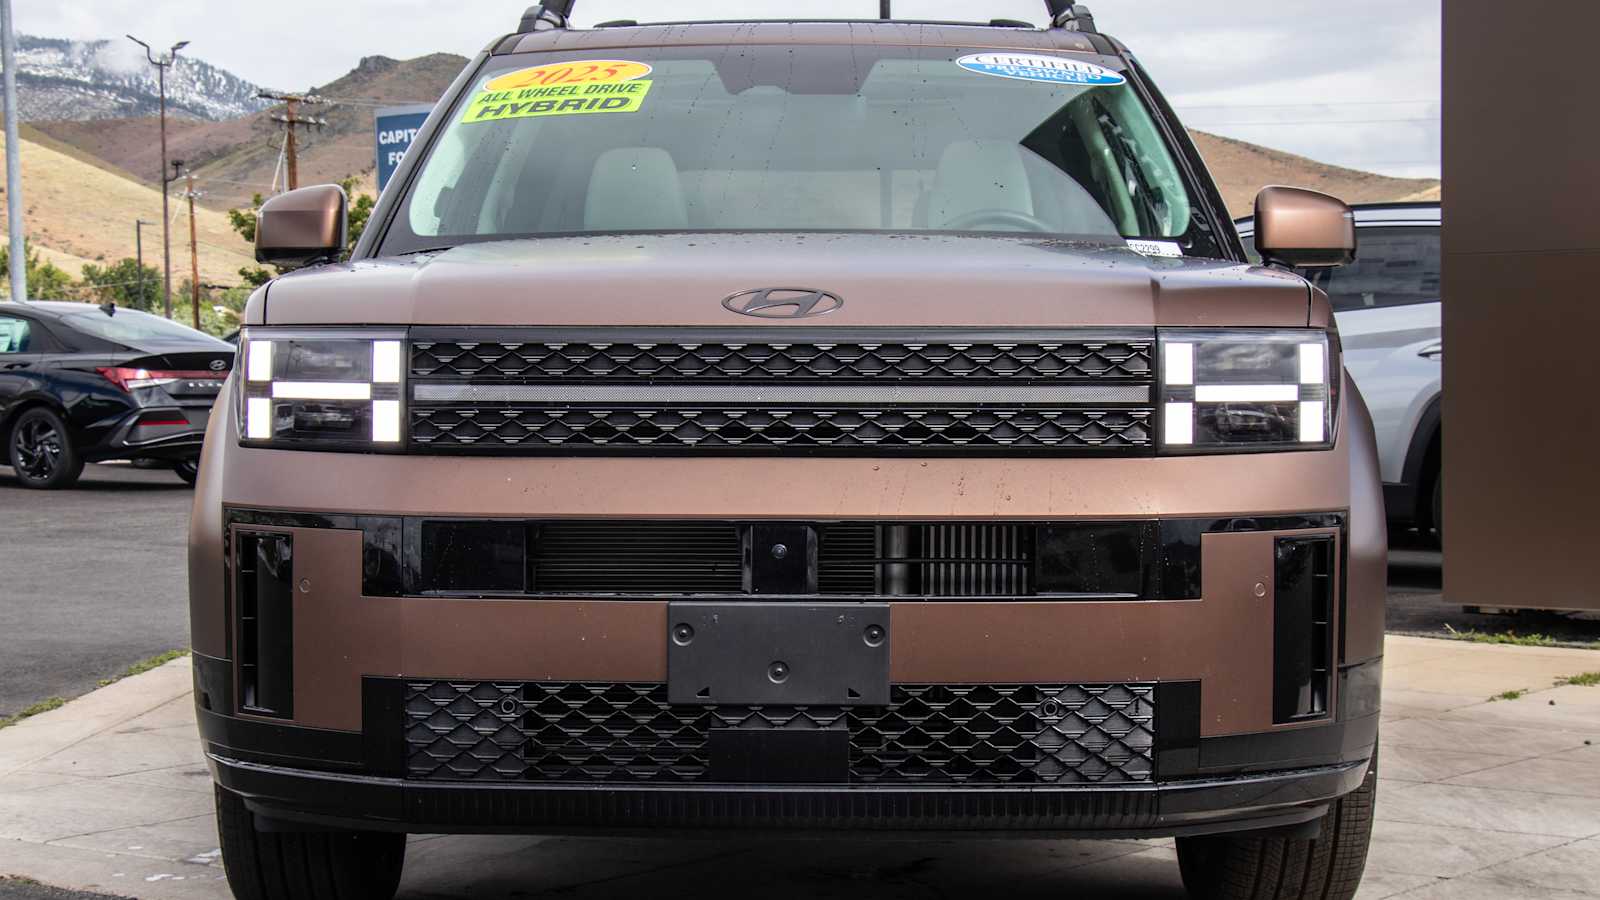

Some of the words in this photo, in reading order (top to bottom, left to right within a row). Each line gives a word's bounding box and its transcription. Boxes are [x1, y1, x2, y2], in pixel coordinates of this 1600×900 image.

[513, 63, 629, 89] 2025
[975, 56, 1104, 75] CERTIFIED
[477, 91, 512, 104] ALL
[517, 84, 577, 99] WHEEL
[583, 83, 642, 95] DRIVE
[476, 96, 633, 119] HYBRID
